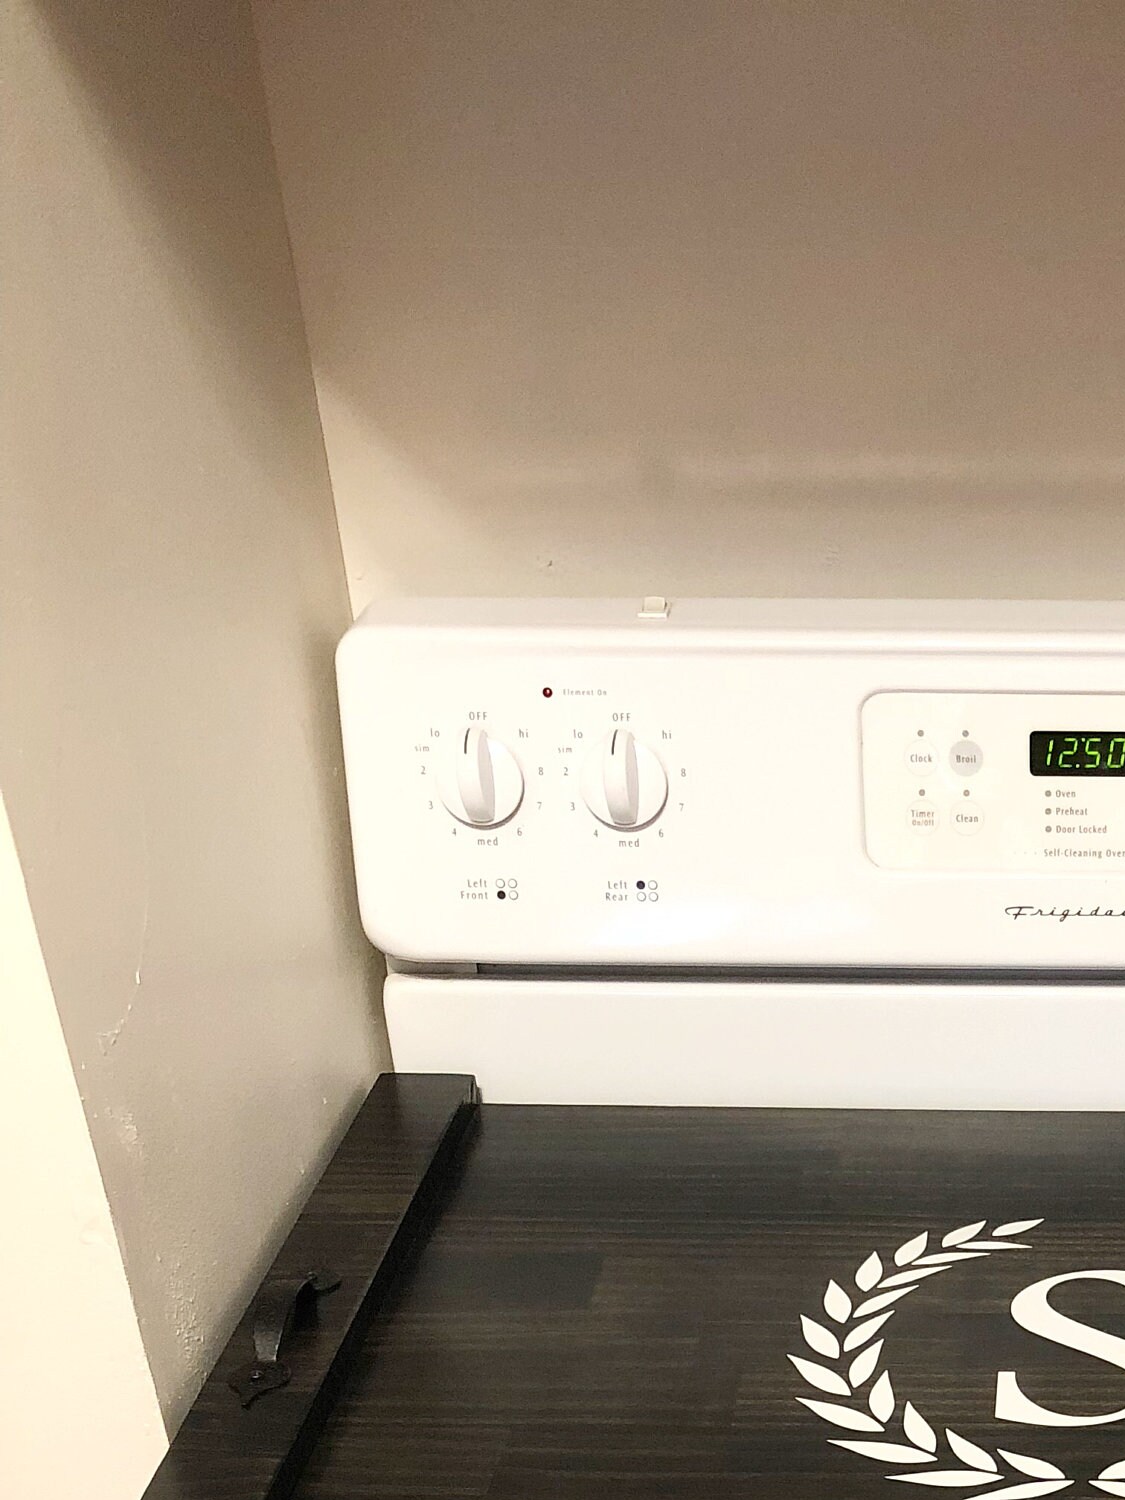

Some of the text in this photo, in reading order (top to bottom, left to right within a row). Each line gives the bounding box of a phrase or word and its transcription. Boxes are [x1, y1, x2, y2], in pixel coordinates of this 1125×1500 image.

[469, 711, 487, 721] OFF
[613, 713, 631, 722] OFF
[430, 728, 440, 738] lo
[518, 728, 529, 739] hi
[573, 729, 583, 739] lo
[662, 729, 672, 740] hi
[414, 744, 430, 752] sim
[558, 745, 572, 753] sim
[910, 753, 932, 763] Clock
[955, 754, 977, 764] Broil
[420, 766, 426, 775] 2
[538, 767, 544, 776] 8
[563, 767, 569, 776] 2
[681, 768, 686, 777] 8
[1055, 789, 1076, 798] Oven
[428, 801, 434, 810] 3
[537, 801, 542, 810] 7
[570, 802, 575, 811] 3
[679, 803, 684, 812] 7
[911, 809, 935, 818] Timer
[1055, 807, 1088, 816] Preheat
[955, 814, 979, 823] Clean
[452, 828, 457, 837] 4
[517, 828, 522, 837] 6
[593, 829, 598, 838] 4
[658, 829, 664, 838] 6
[1055, 825, 1108, 834] Door Locked
[477, 837, 499, 846] med
[619, 838, 640, 848] med
[1043, 848, 1102, 859] Self-Cleaning
[467, 879, 487, 888] Left
[608, 880, 627, 890] Left
[460, 891, 488, 900] Front
[605, 892, 628, 902] Rear
